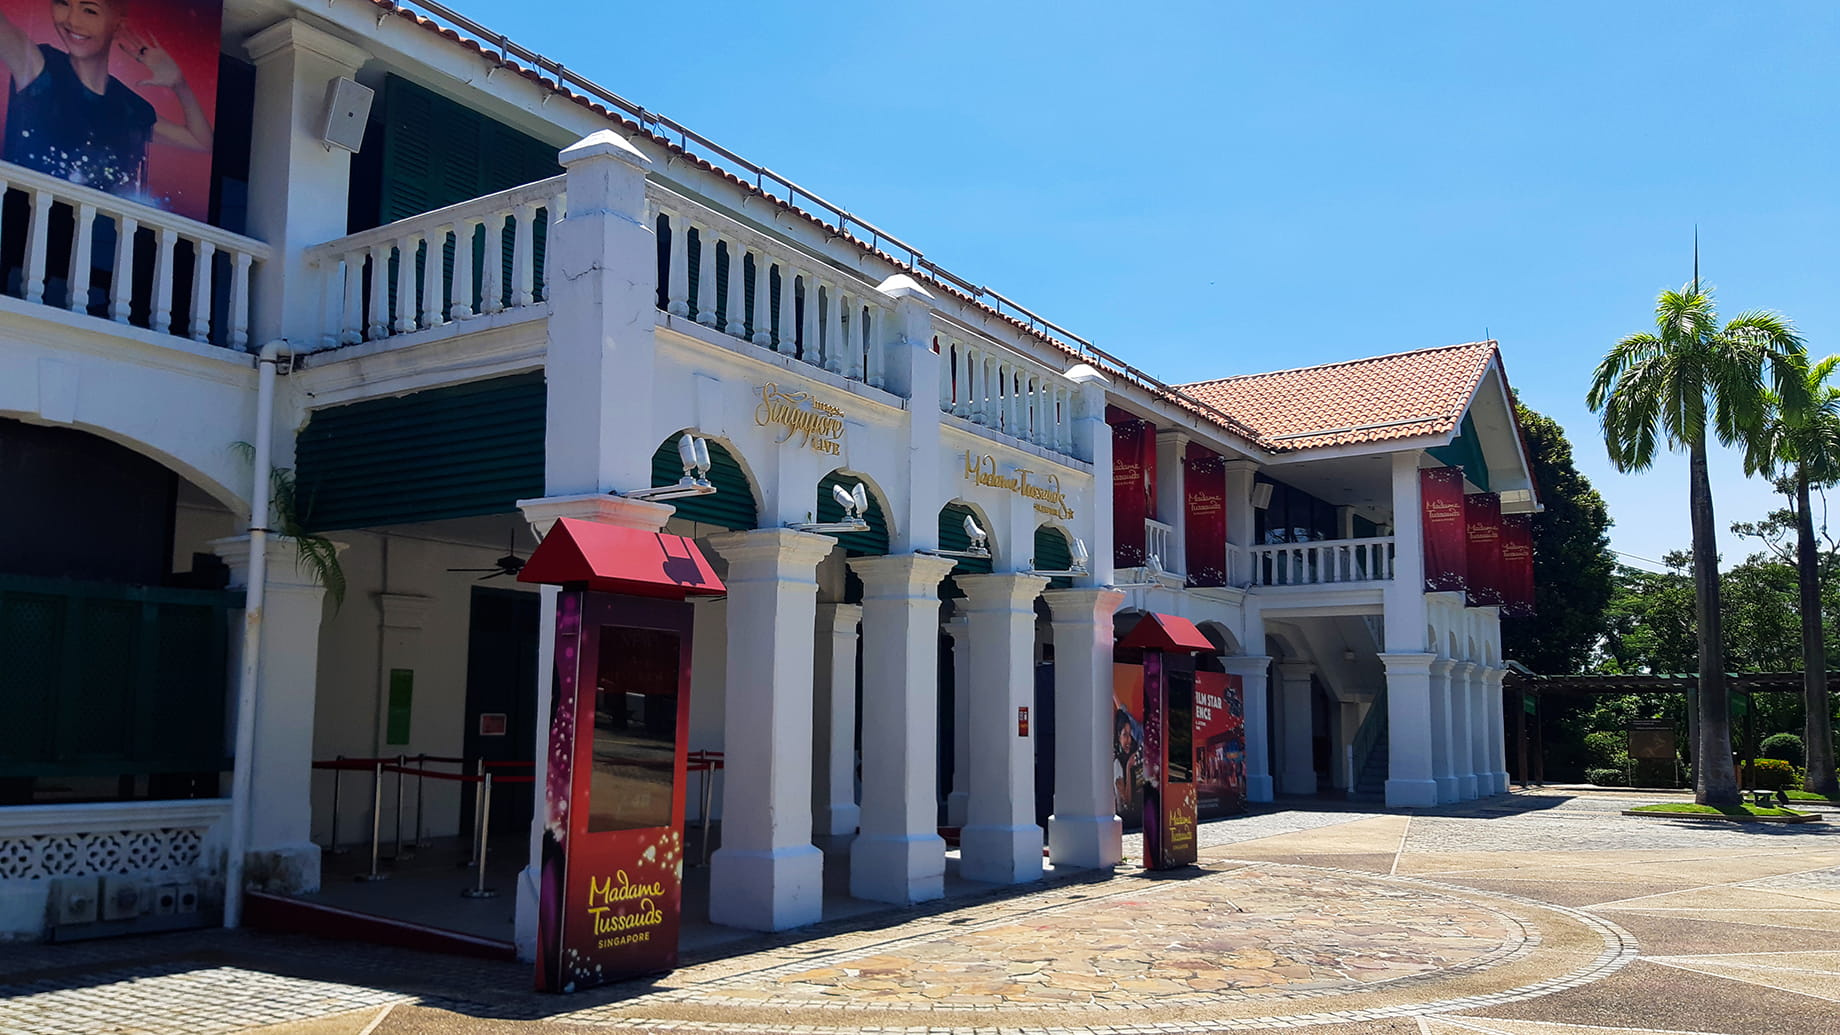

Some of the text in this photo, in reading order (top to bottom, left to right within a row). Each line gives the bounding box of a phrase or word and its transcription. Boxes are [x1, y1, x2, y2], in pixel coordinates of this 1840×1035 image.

[755, 382, 845, 449] Singapore
[965, 449, 1021, 492] Madame
[1114, 459, 1140, 470] adame
[1207, 694, 1222, 709] STAR
[588, 869, 665, 906] Madame
[587, 898, 663, 935] Tussauds
[598, 931, 651, 949] SINGAPORE
